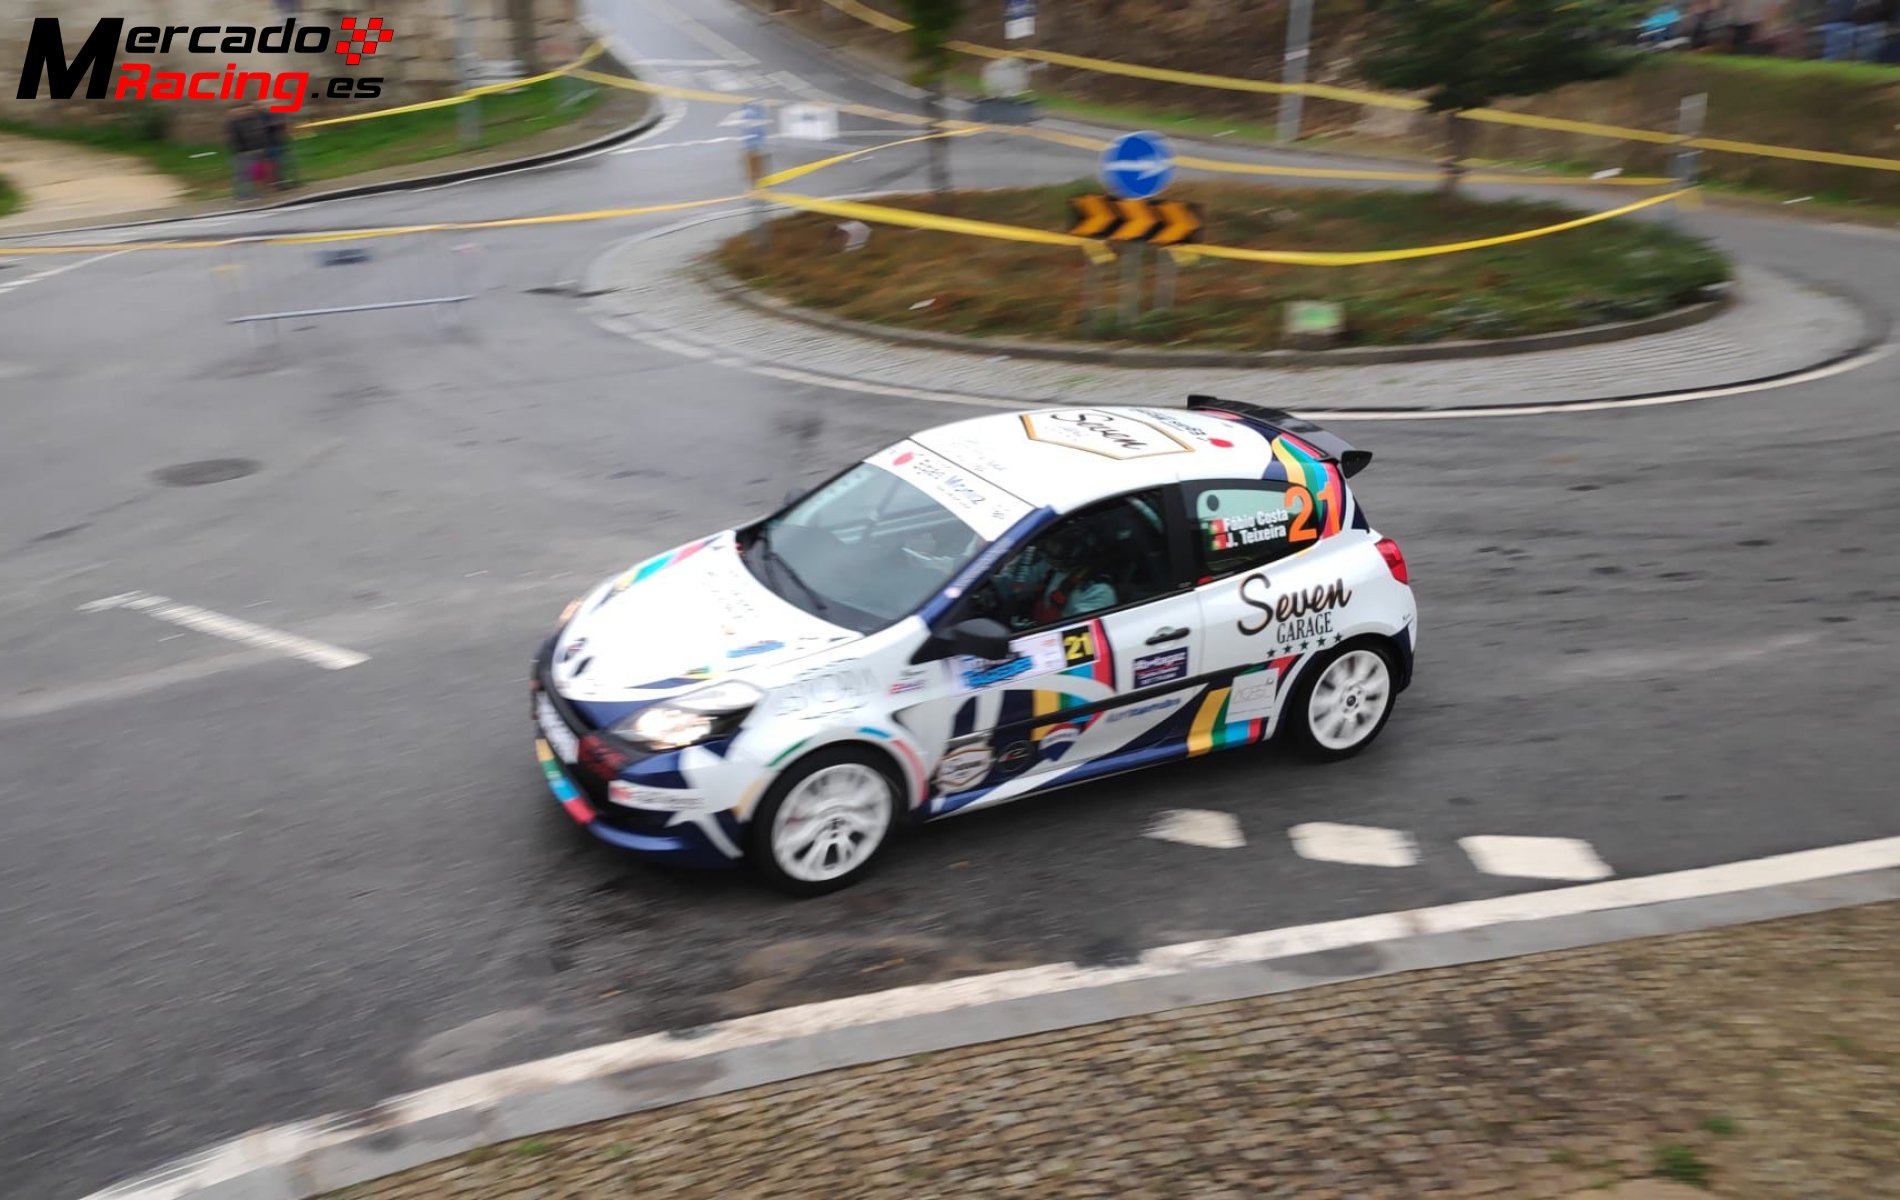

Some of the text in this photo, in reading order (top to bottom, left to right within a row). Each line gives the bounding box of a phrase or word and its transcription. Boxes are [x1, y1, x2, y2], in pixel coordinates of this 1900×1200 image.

[1256, 507, 1289, 526] Costa
[1283, 486, 1341, 542] 21
[1239, 525, 1287, 545] Teixeira
[1237, 572, 1352, 636] Seven
[1276, 611, 1333, 644] GARAGE
[1063, 632, 1093, 661] 21
